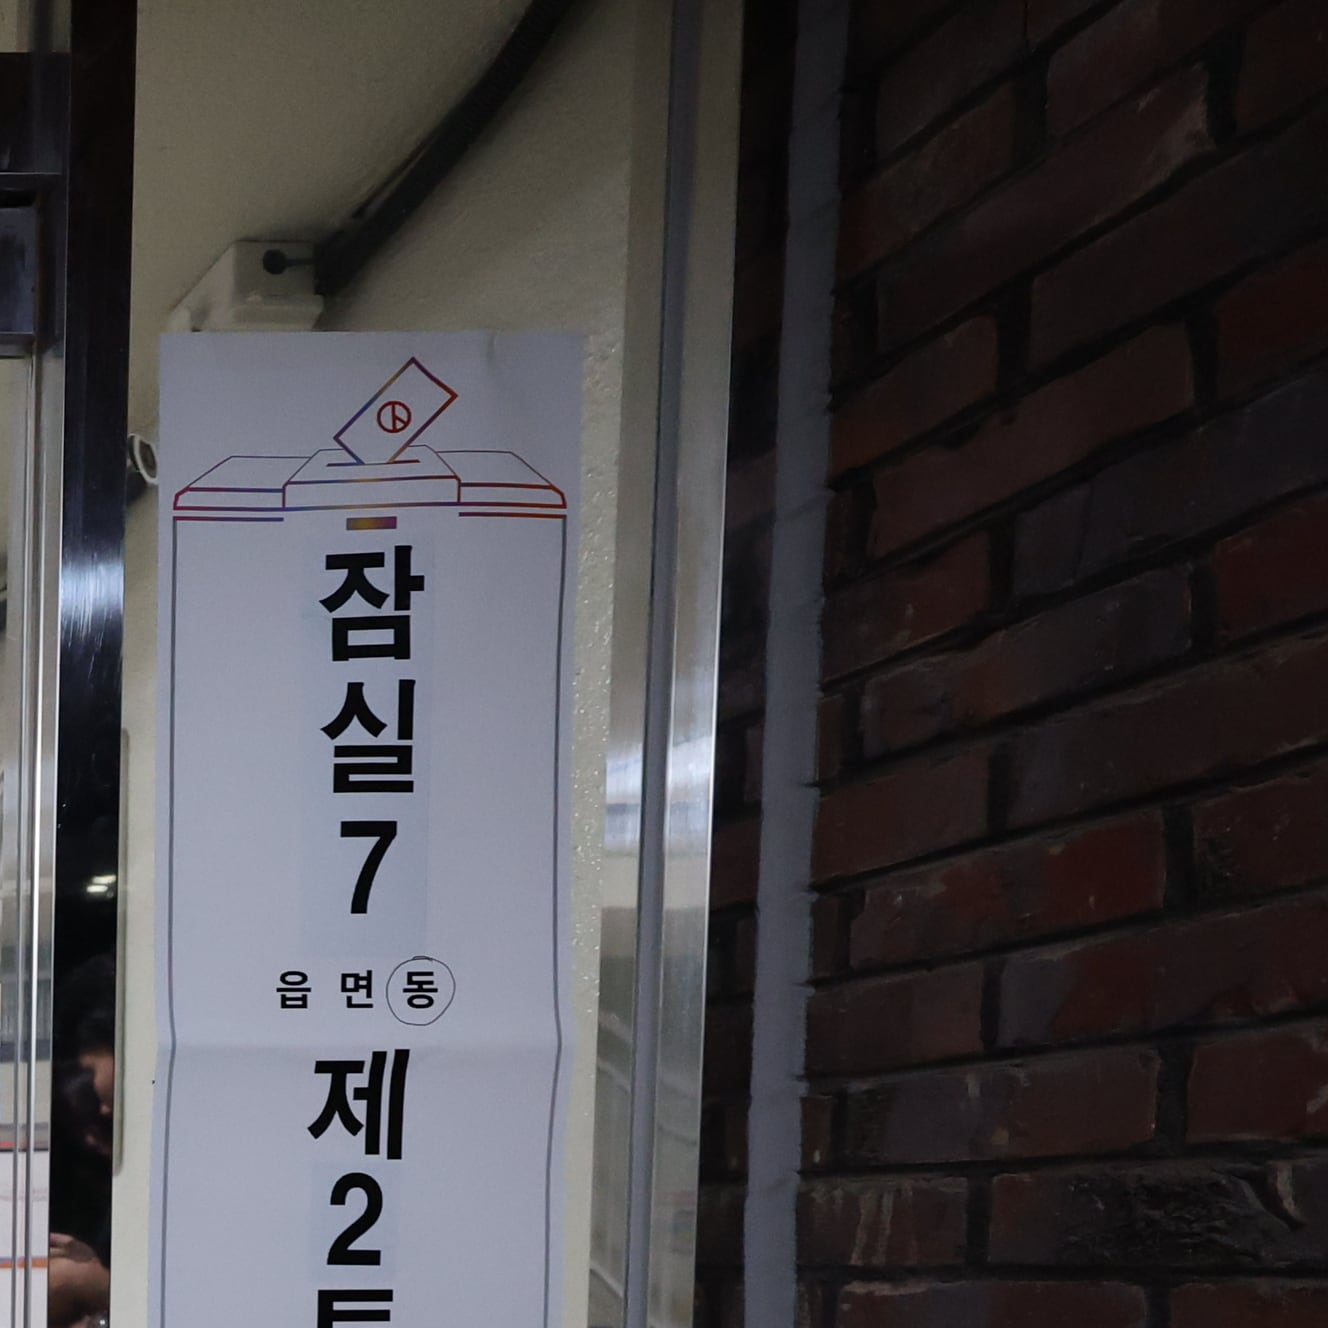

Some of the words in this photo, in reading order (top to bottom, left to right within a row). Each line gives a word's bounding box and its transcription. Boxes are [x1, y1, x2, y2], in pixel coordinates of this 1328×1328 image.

[319, 545, 425, 915] 잠실7
[275, 971, 313, 1010] 읍
[340, 970, 374, 1009] 면
[402, 970, 440, 1009] 동
